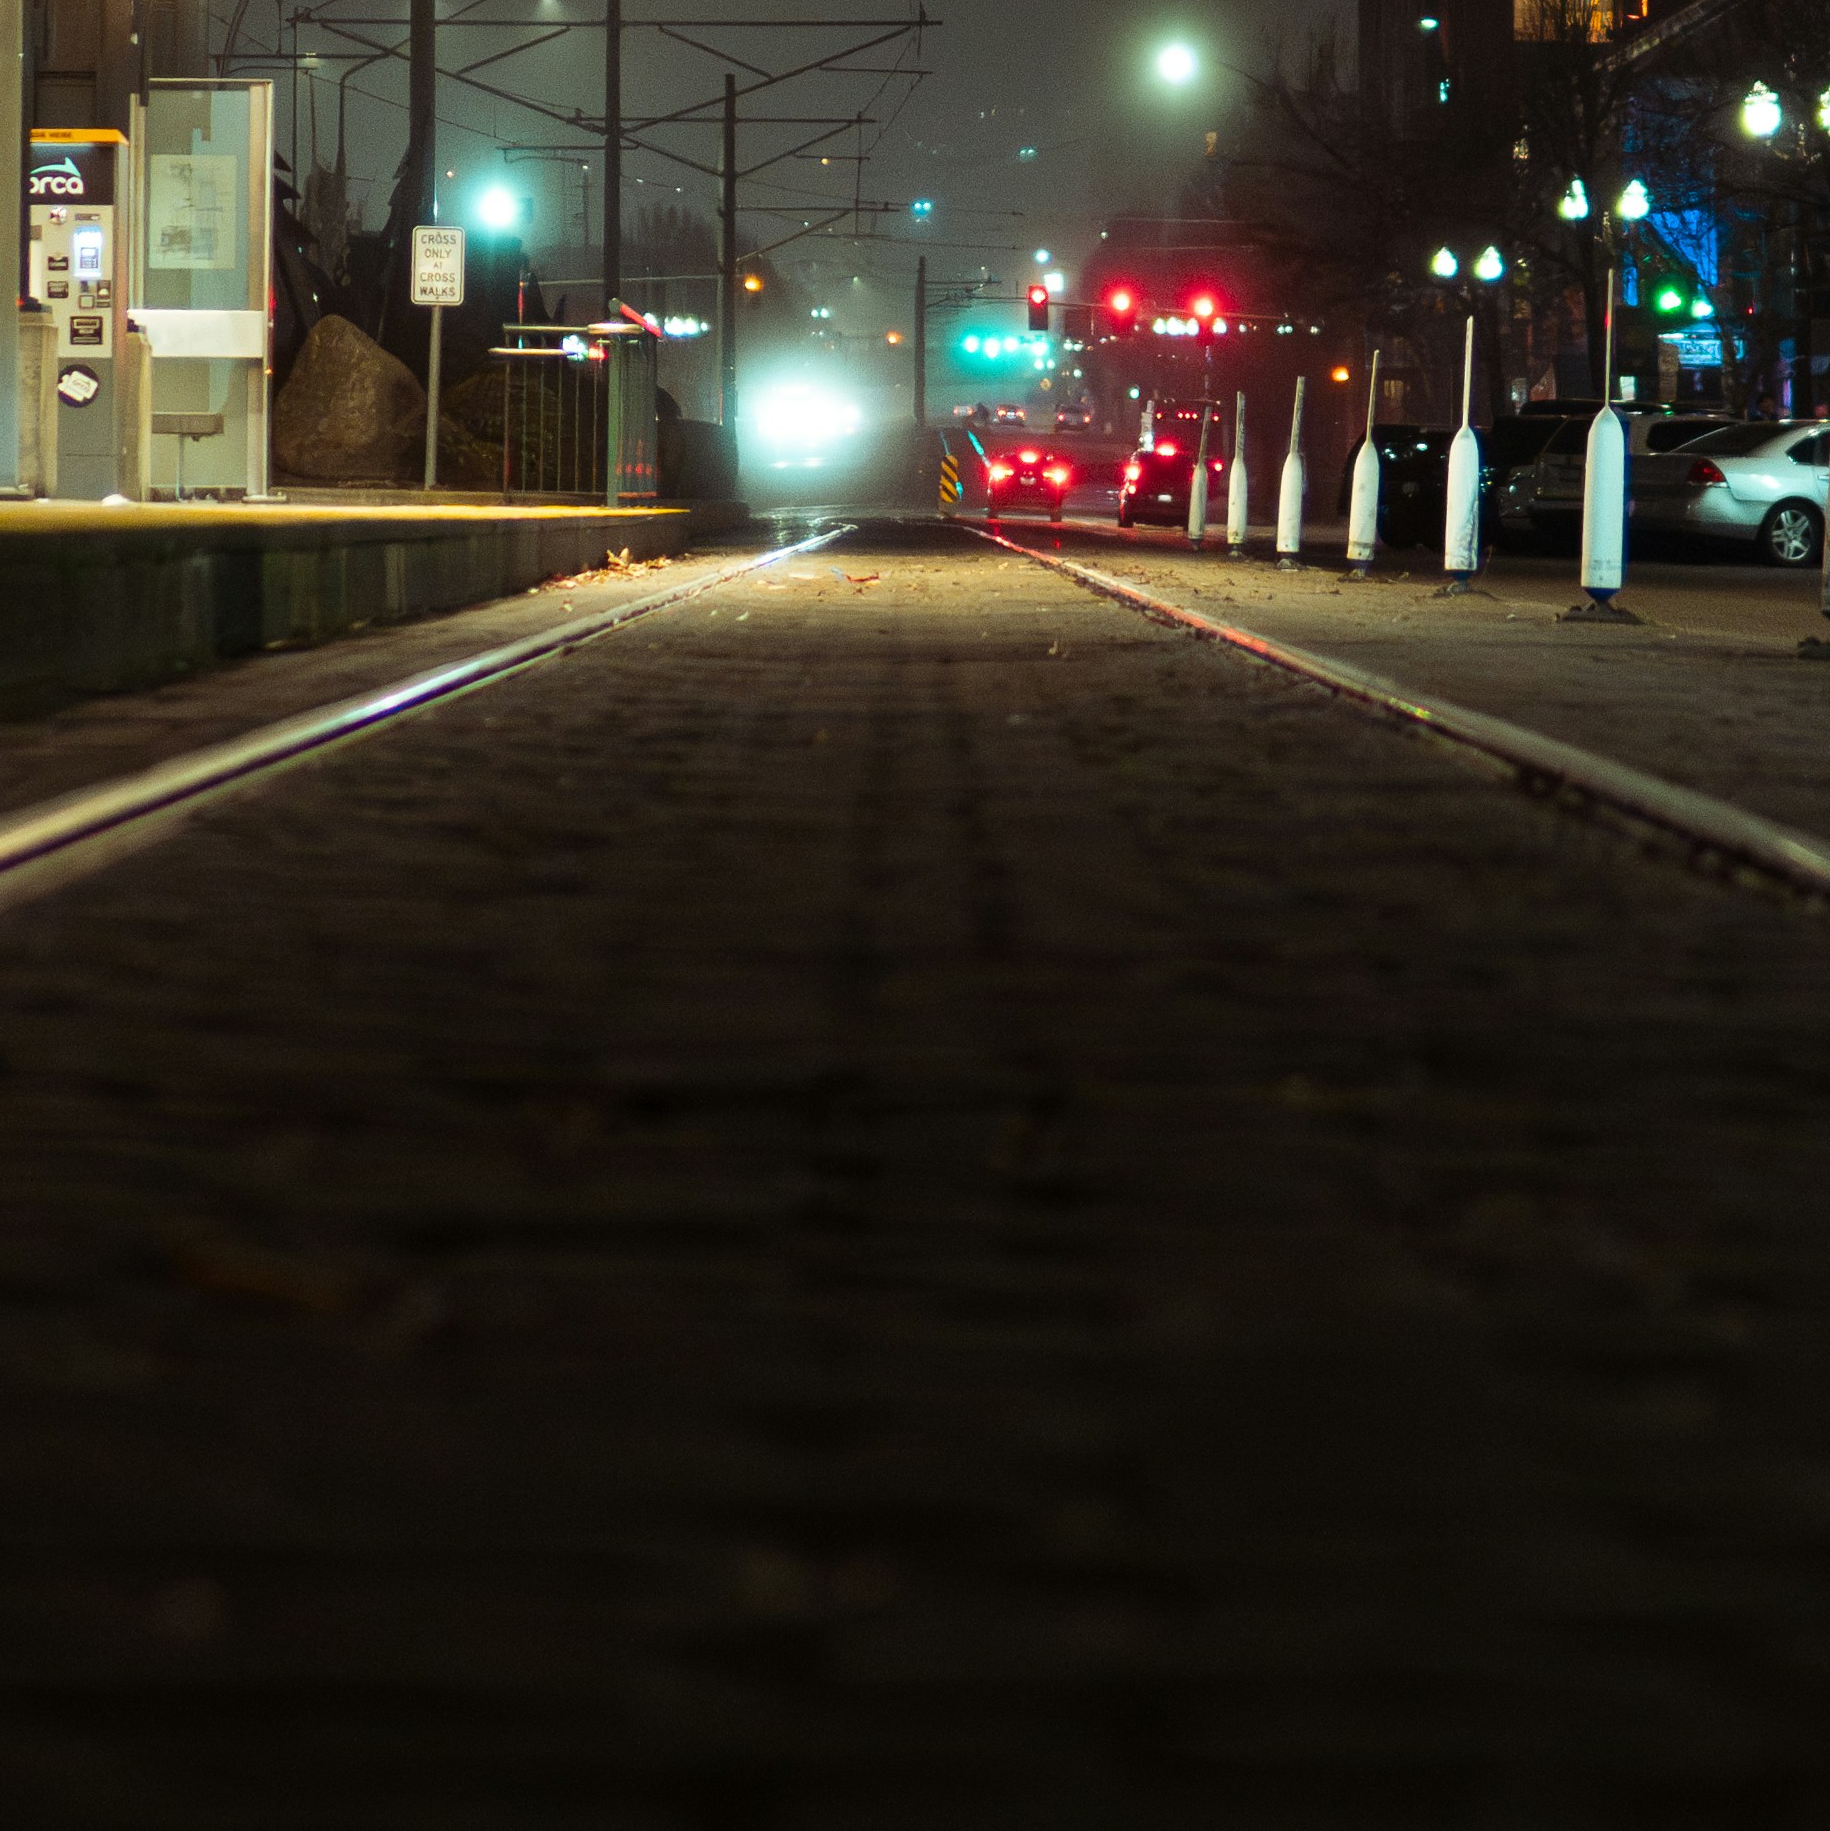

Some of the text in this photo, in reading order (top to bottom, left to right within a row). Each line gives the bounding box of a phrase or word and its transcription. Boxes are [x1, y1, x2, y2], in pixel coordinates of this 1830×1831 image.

[421, 234, 457, 245] CROSS
[424, 248, 452, 259] ONLY
[420, 272, 456, 283] CROSS
[419, 286, 456, 297] WALKS
